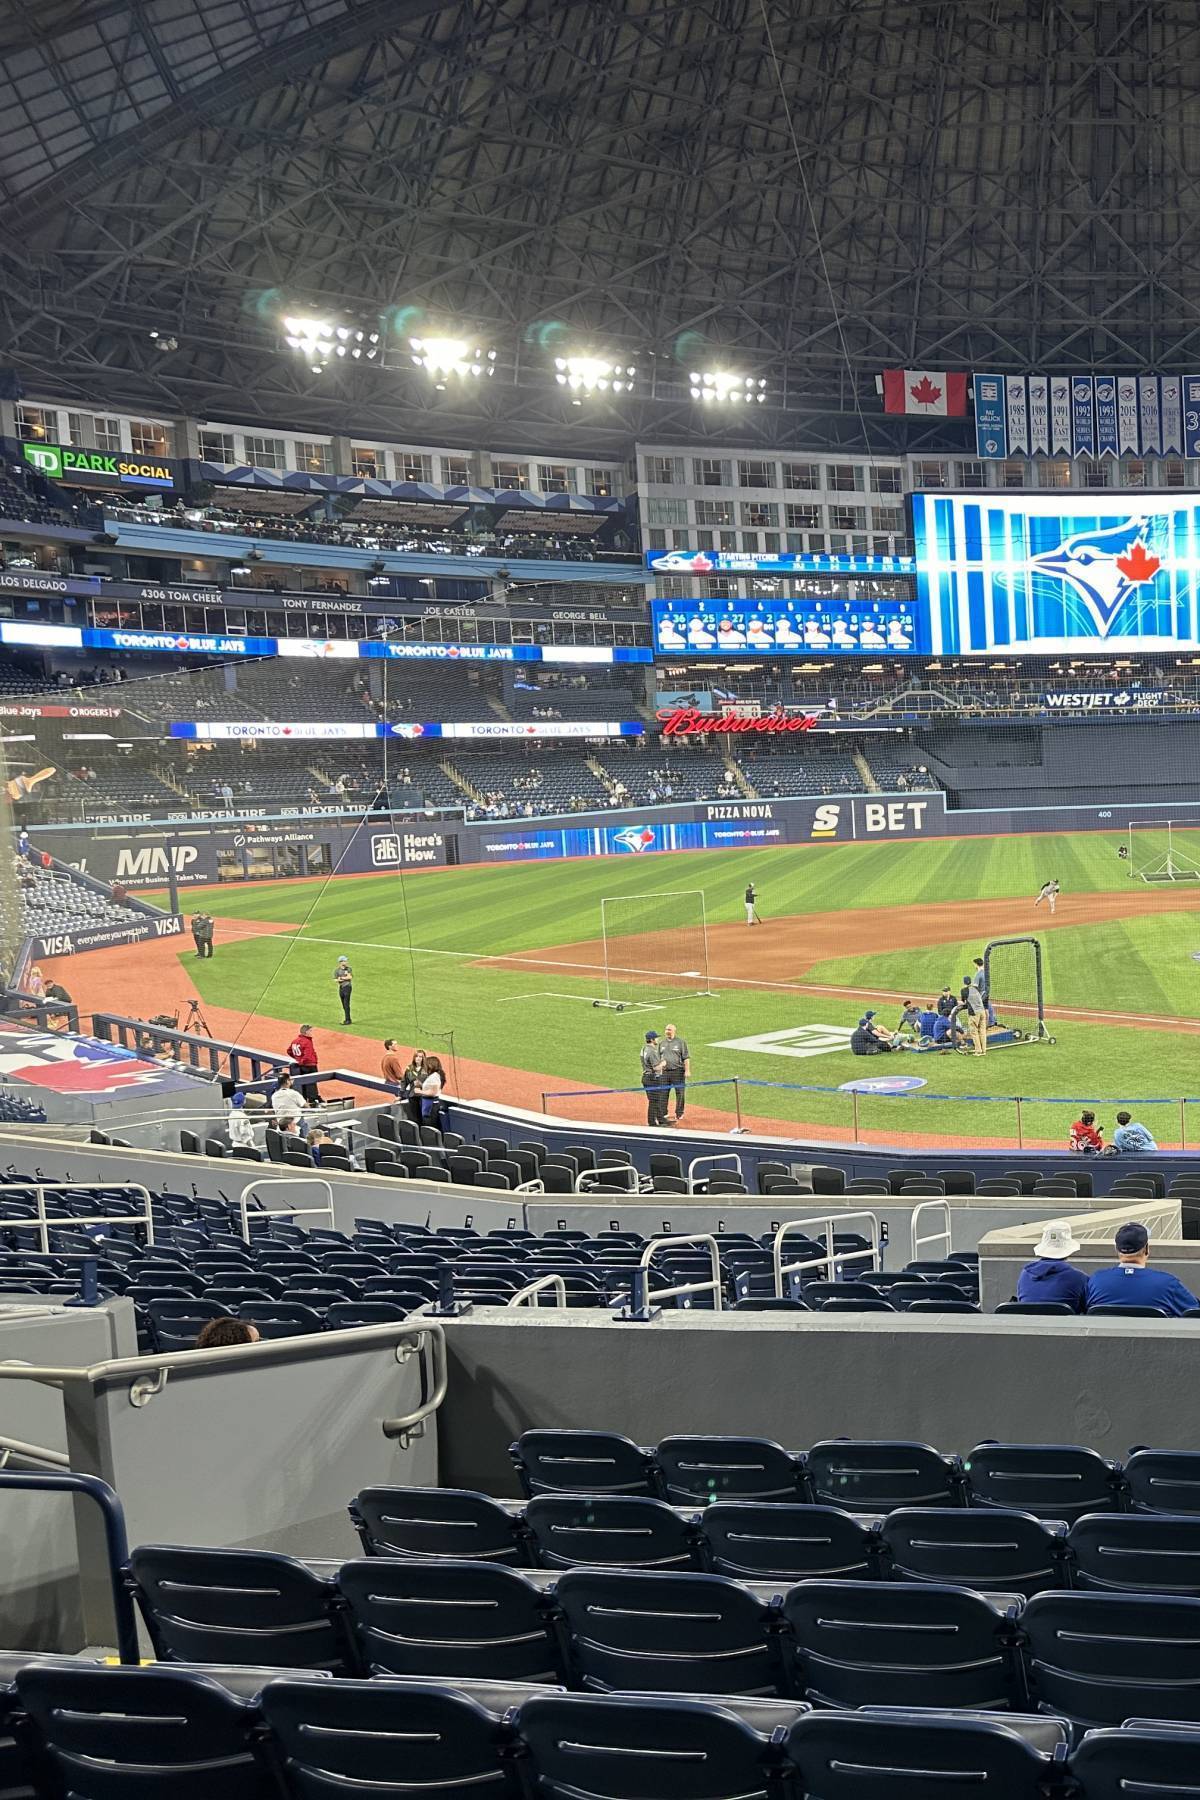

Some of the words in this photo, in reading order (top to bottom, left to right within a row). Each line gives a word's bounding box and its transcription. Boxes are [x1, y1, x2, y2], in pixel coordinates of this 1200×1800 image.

[28, 449, 59, 472] TD
[63, 451, 118, 474] PARK
[119, 462, 174, 480] SOCIAL
[23, 579, 67, 591] DELGADO
[141, 589, 166, 600] 4306
[168, 591, 190, 601] TOM
[193, 593, 223, 604] CHEEK
[282, 599, 308, 610] TONY
[311, 600, 362, 612] FERNANDEZ
[424, 606, 440, 616] JOE
[444, 607, 476, 617] CARTER
[552, 611, 586, 621] GEORGE
[589, 611, 607, 621] BELL
[112, 633, 176, 649] TORONTO
[189, 638, 217, 651] BLUE
[218, 640, 246, 653] JAYS
[388, 645, 447, 657] TORONTO
[459, 647, 485, 658] BLUE
[487, 648, 513, 660] JAYS
[1047, 693, 1113, 708] WESTJET
[1133, 692, 1162, 701] FLIGHT
[1137, 700, 1159, 708] DECK
[20, 707, 42, 717] Jays
[79, 708, 108, 717] ROGERS
[656, 708, 817, 735] Budweiser
[225, 726, 280, 736] TORONTO
[471, 725, 525, 735] TORONTO
[707, 806, 740, 820] PIZZA
[743, 804, 772, 819] NOVA
[865, 801, 928, 832] BET
[247, 834, 283, 844] Pathways
[284, 833, 314, 842] Alliance
[404, 833, 442, 847] Here's
[405, 848, 436, 861] How.
[486, 844, 518, 852] TORONTO
[116, 846, 198, 876] MNP
[175, 874, 194, 882] Takes
[195, 872, 208, 880] You
[41, 935, 75, 956] VISA
[77, 934, 111, 946] everywhere
[154, 917, 181, 936] VISA
